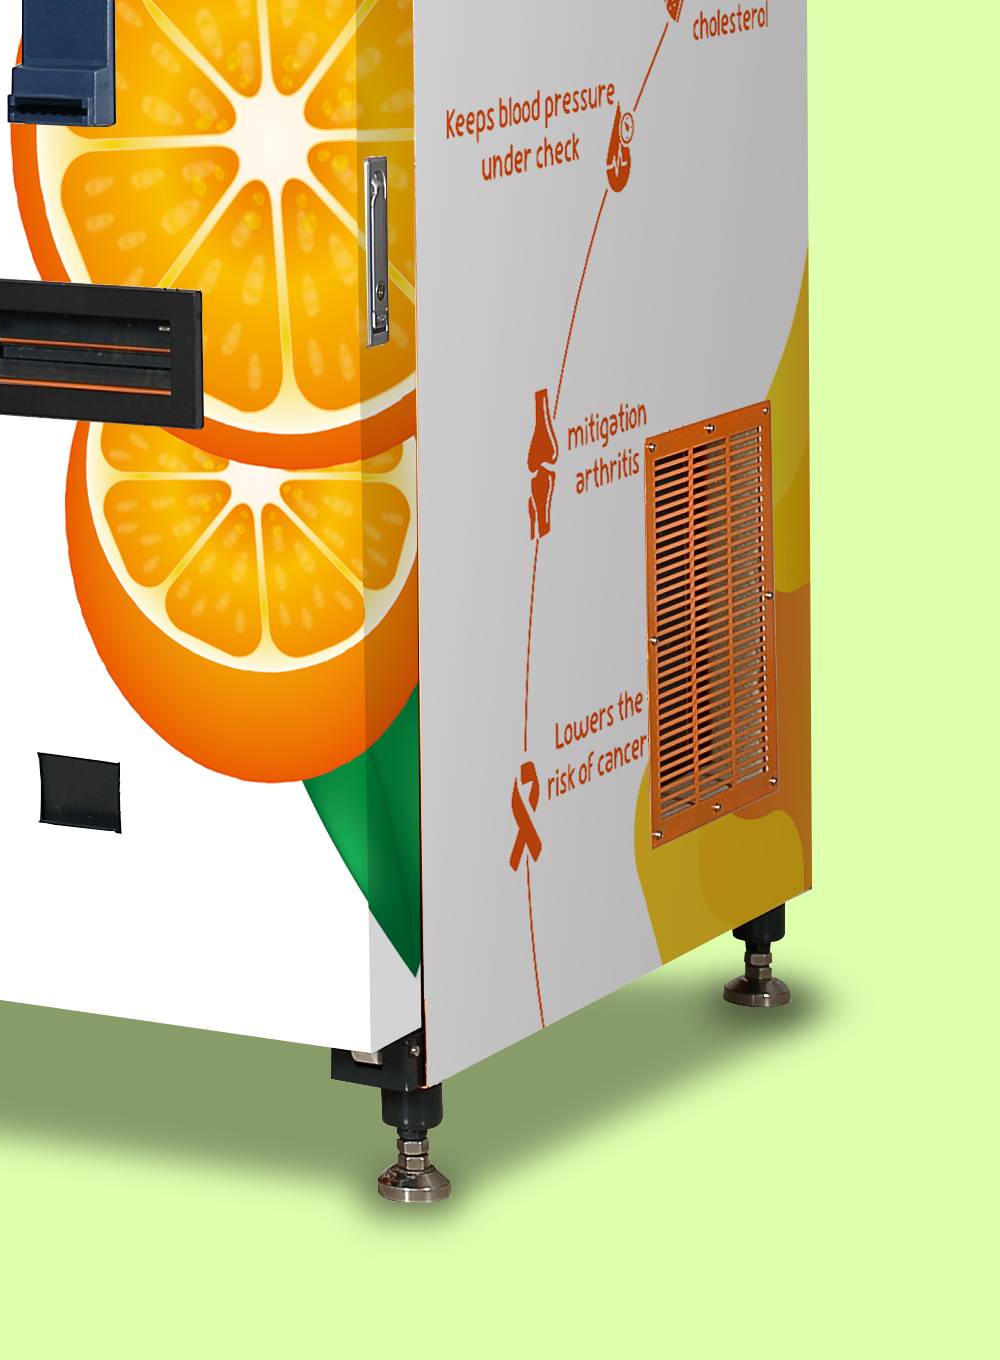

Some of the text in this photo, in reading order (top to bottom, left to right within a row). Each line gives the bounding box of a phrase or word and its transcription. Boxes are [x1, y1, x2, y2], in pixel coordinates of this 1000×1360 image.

[692, 0, 769, 41] cholesterol
[445, 83, 615, 143] Keeps blood pressure
[481, 133, 579, 181] under check
[567, 403, 647, 451] mitigation
[576, 448, 640, 494] arthritis
[555, 689, 643, 750] Lowers the
[547, 735, 647, 800] risk of cancer
